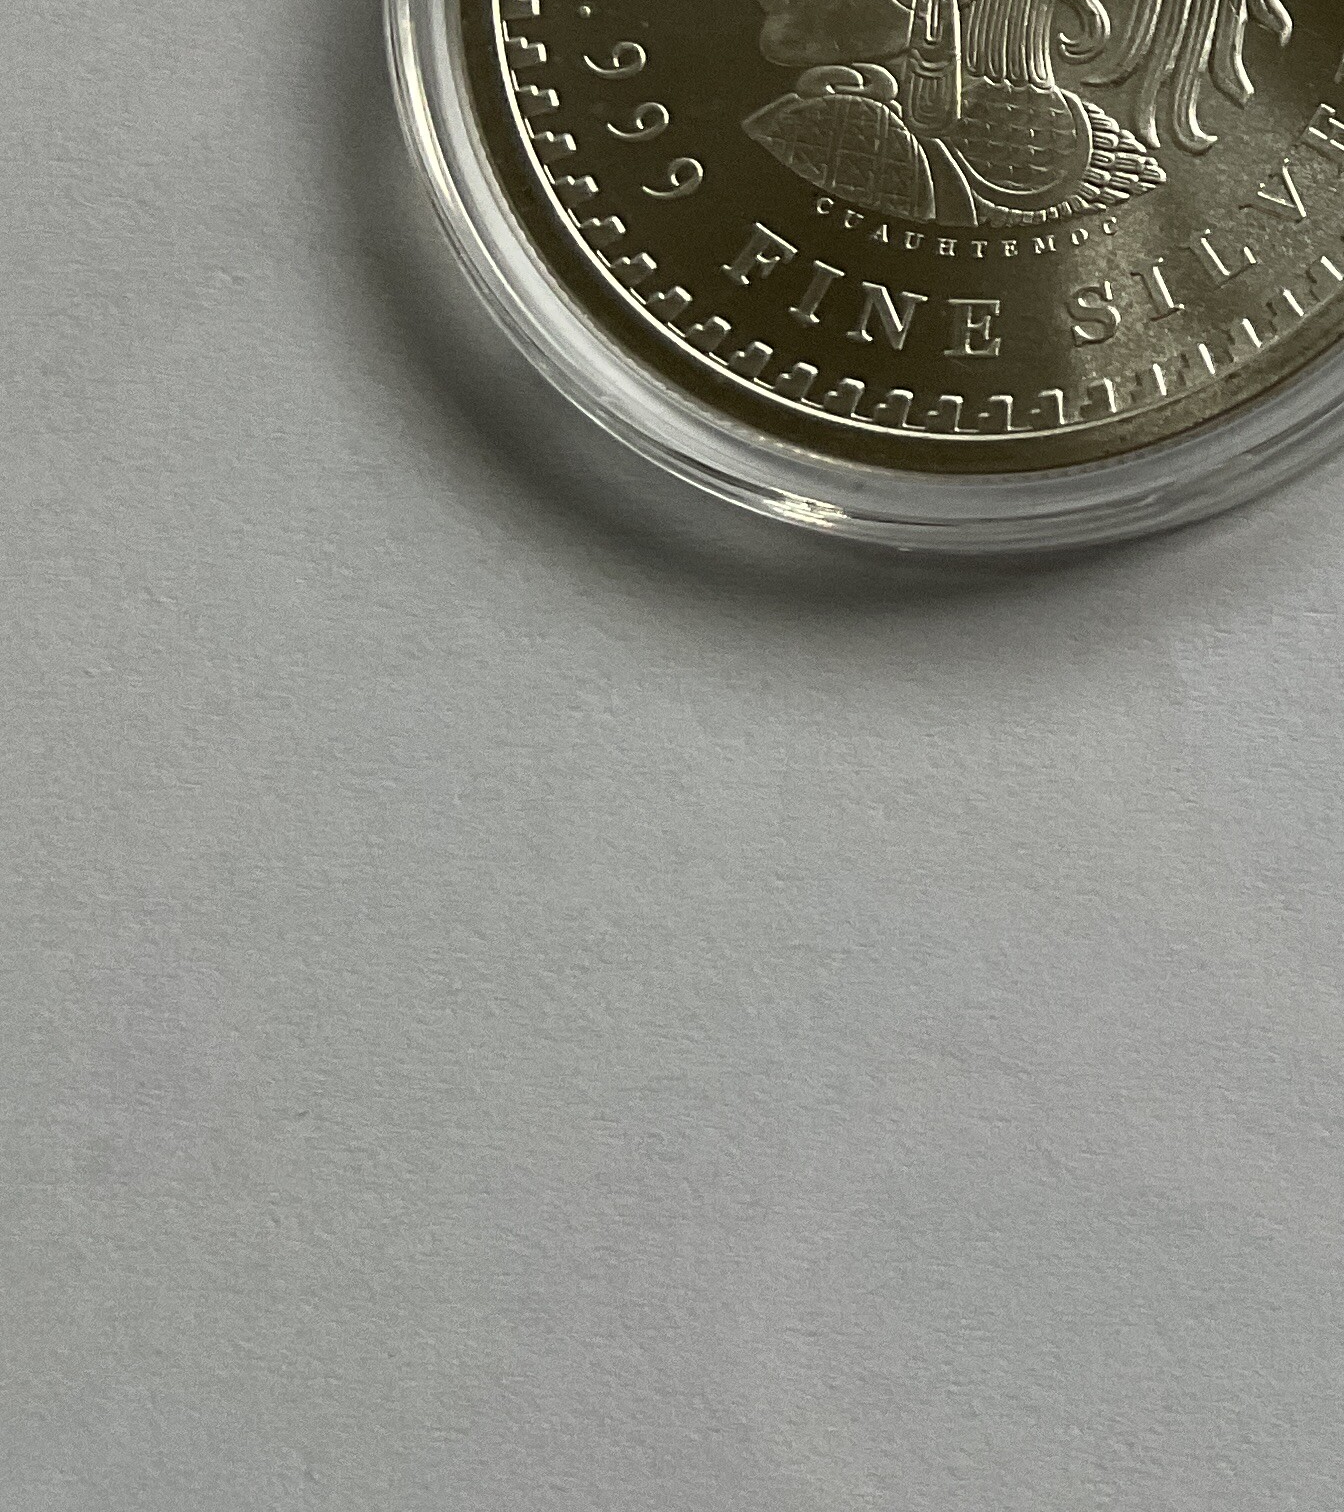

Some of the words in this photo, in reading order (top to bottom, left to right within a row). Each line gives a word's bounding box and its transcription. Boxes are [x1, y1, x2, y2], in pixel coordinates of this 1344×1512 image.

[579, 5, 704, 199] .999
[721, 222, 1002, 359] FINE
[816, 196, 1119, 259] CUAUHTEMOC
